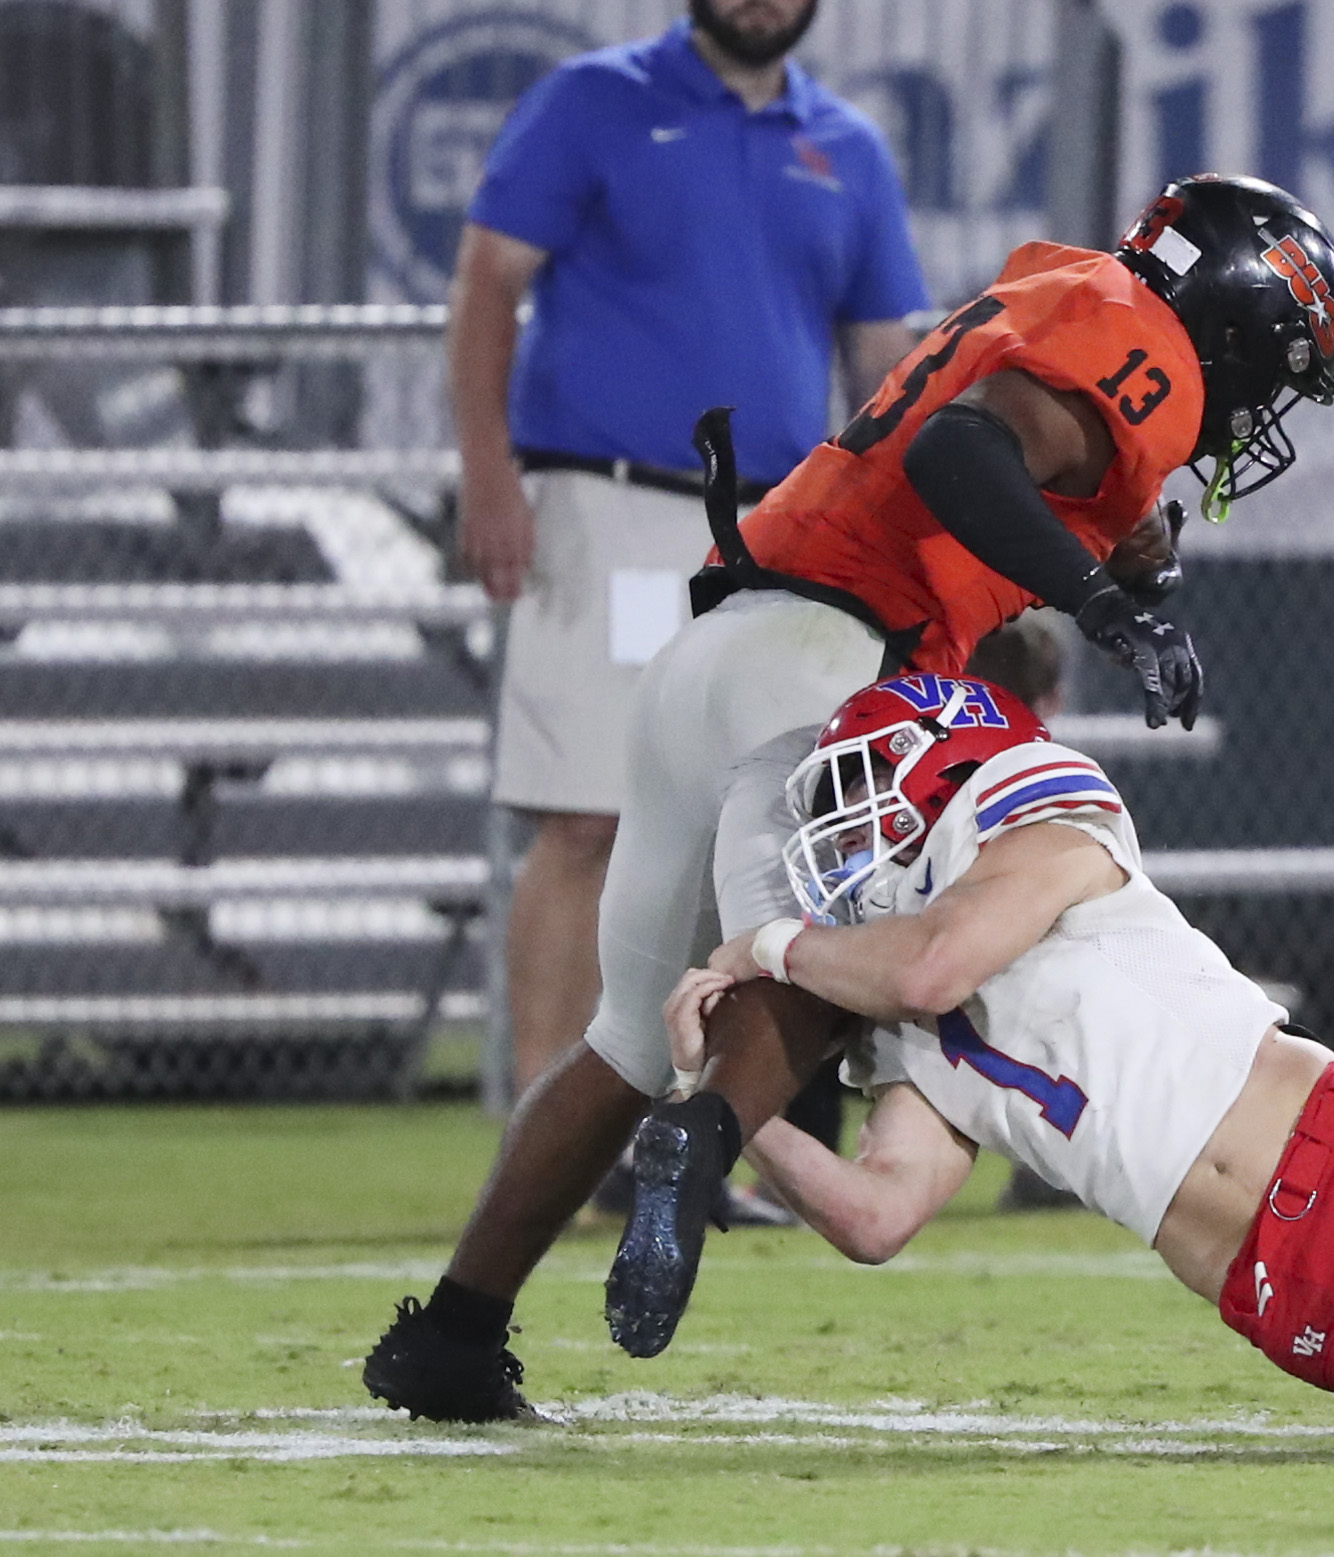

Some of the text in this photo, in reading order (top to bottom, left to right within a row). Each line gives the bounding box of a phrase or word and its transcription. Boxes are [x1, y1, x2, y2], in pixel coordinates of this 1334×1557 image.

[1096, 348, 1172, 426] 13
[876, 672, 1010, 729] VH
[936, 1006, 1091, 1142] 1
[1292, 1325, 1326, 1357] VH
